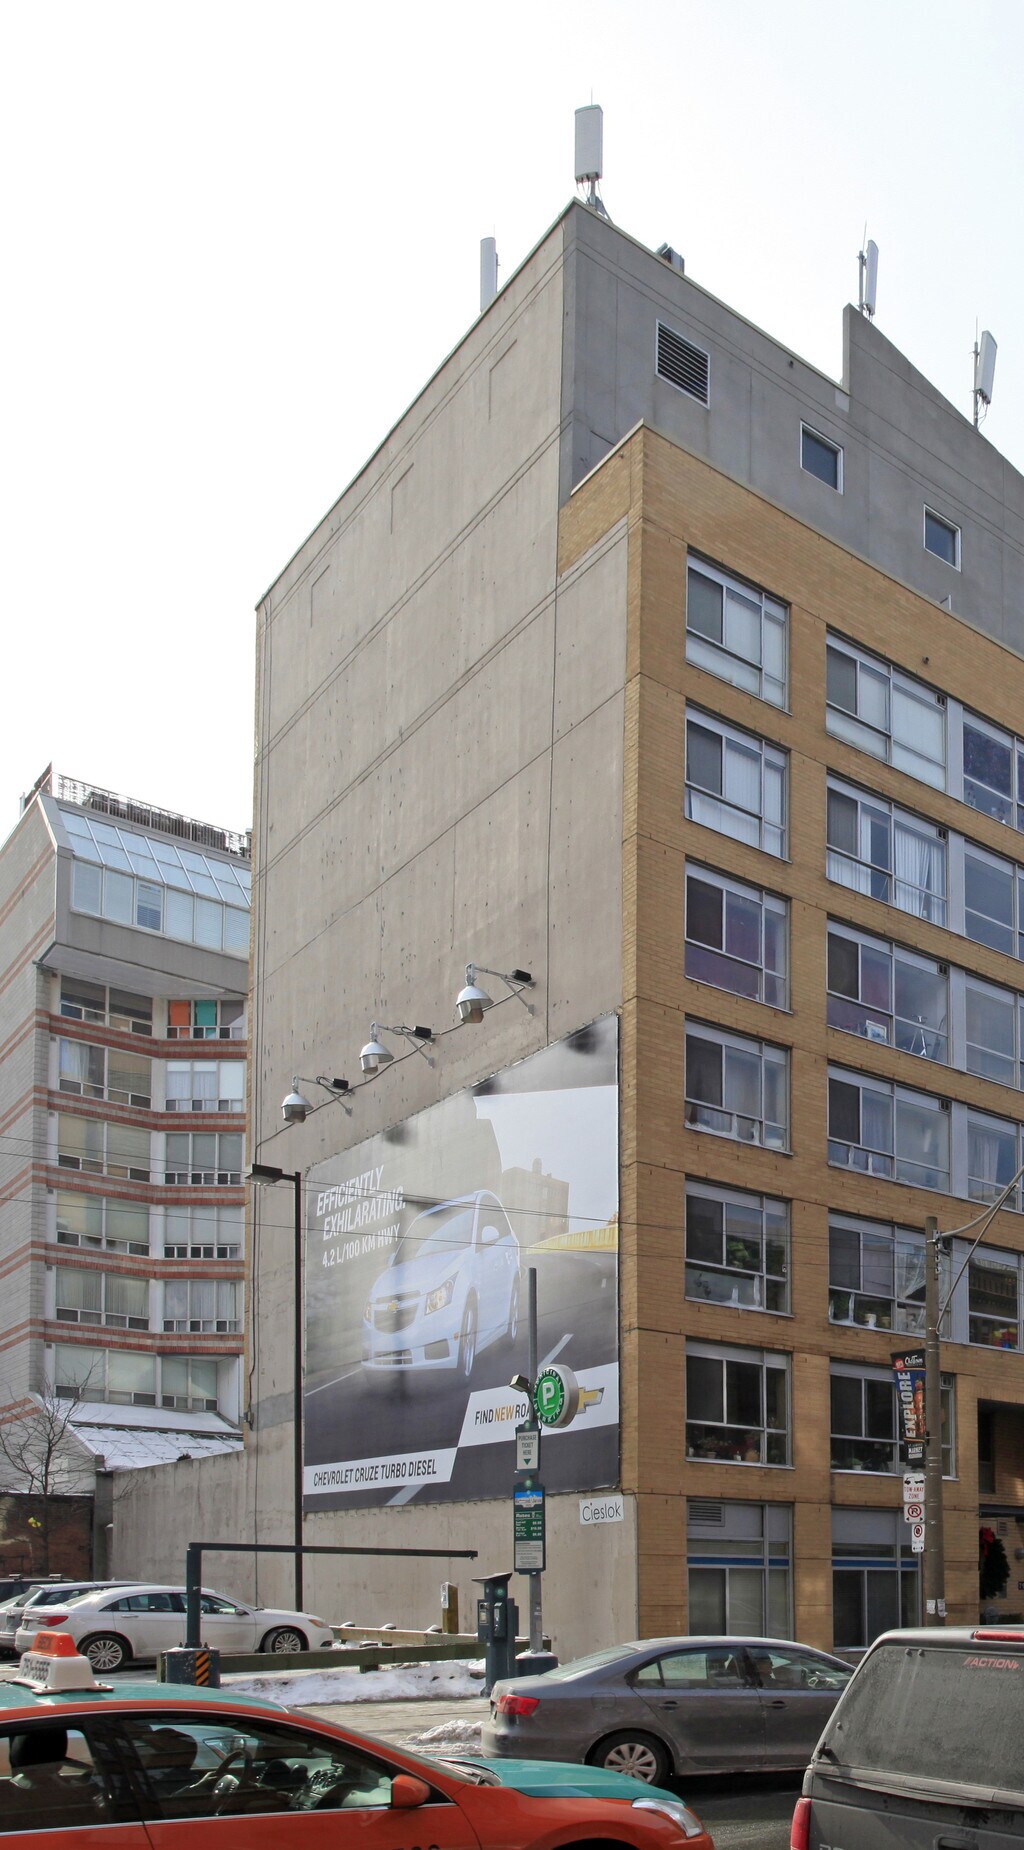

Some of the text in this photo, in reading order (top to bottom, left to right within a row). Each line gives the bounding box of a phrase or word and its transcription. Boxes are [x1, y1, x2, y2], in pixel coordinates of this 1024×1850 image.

[316, 1164, 385, 1217] EFFICIENTLY
[323, 1185, 406, 1241] EXHILARATING.
[322, 1223, 401, 1268] 4.2 L/100 KM HWY
[475, 1409, 494, 1425] FIND
[494, 1405, 515, 1422] NEW
[898, 1371, 916, 1438] EXPLORE
[313, 1459, 437, 1487] CHEVROLET CRUZE TURBO DIESEL
[582, 1502, 621, 1522] Cieslok
[970, 1657, 1014, 1669] ACTION
